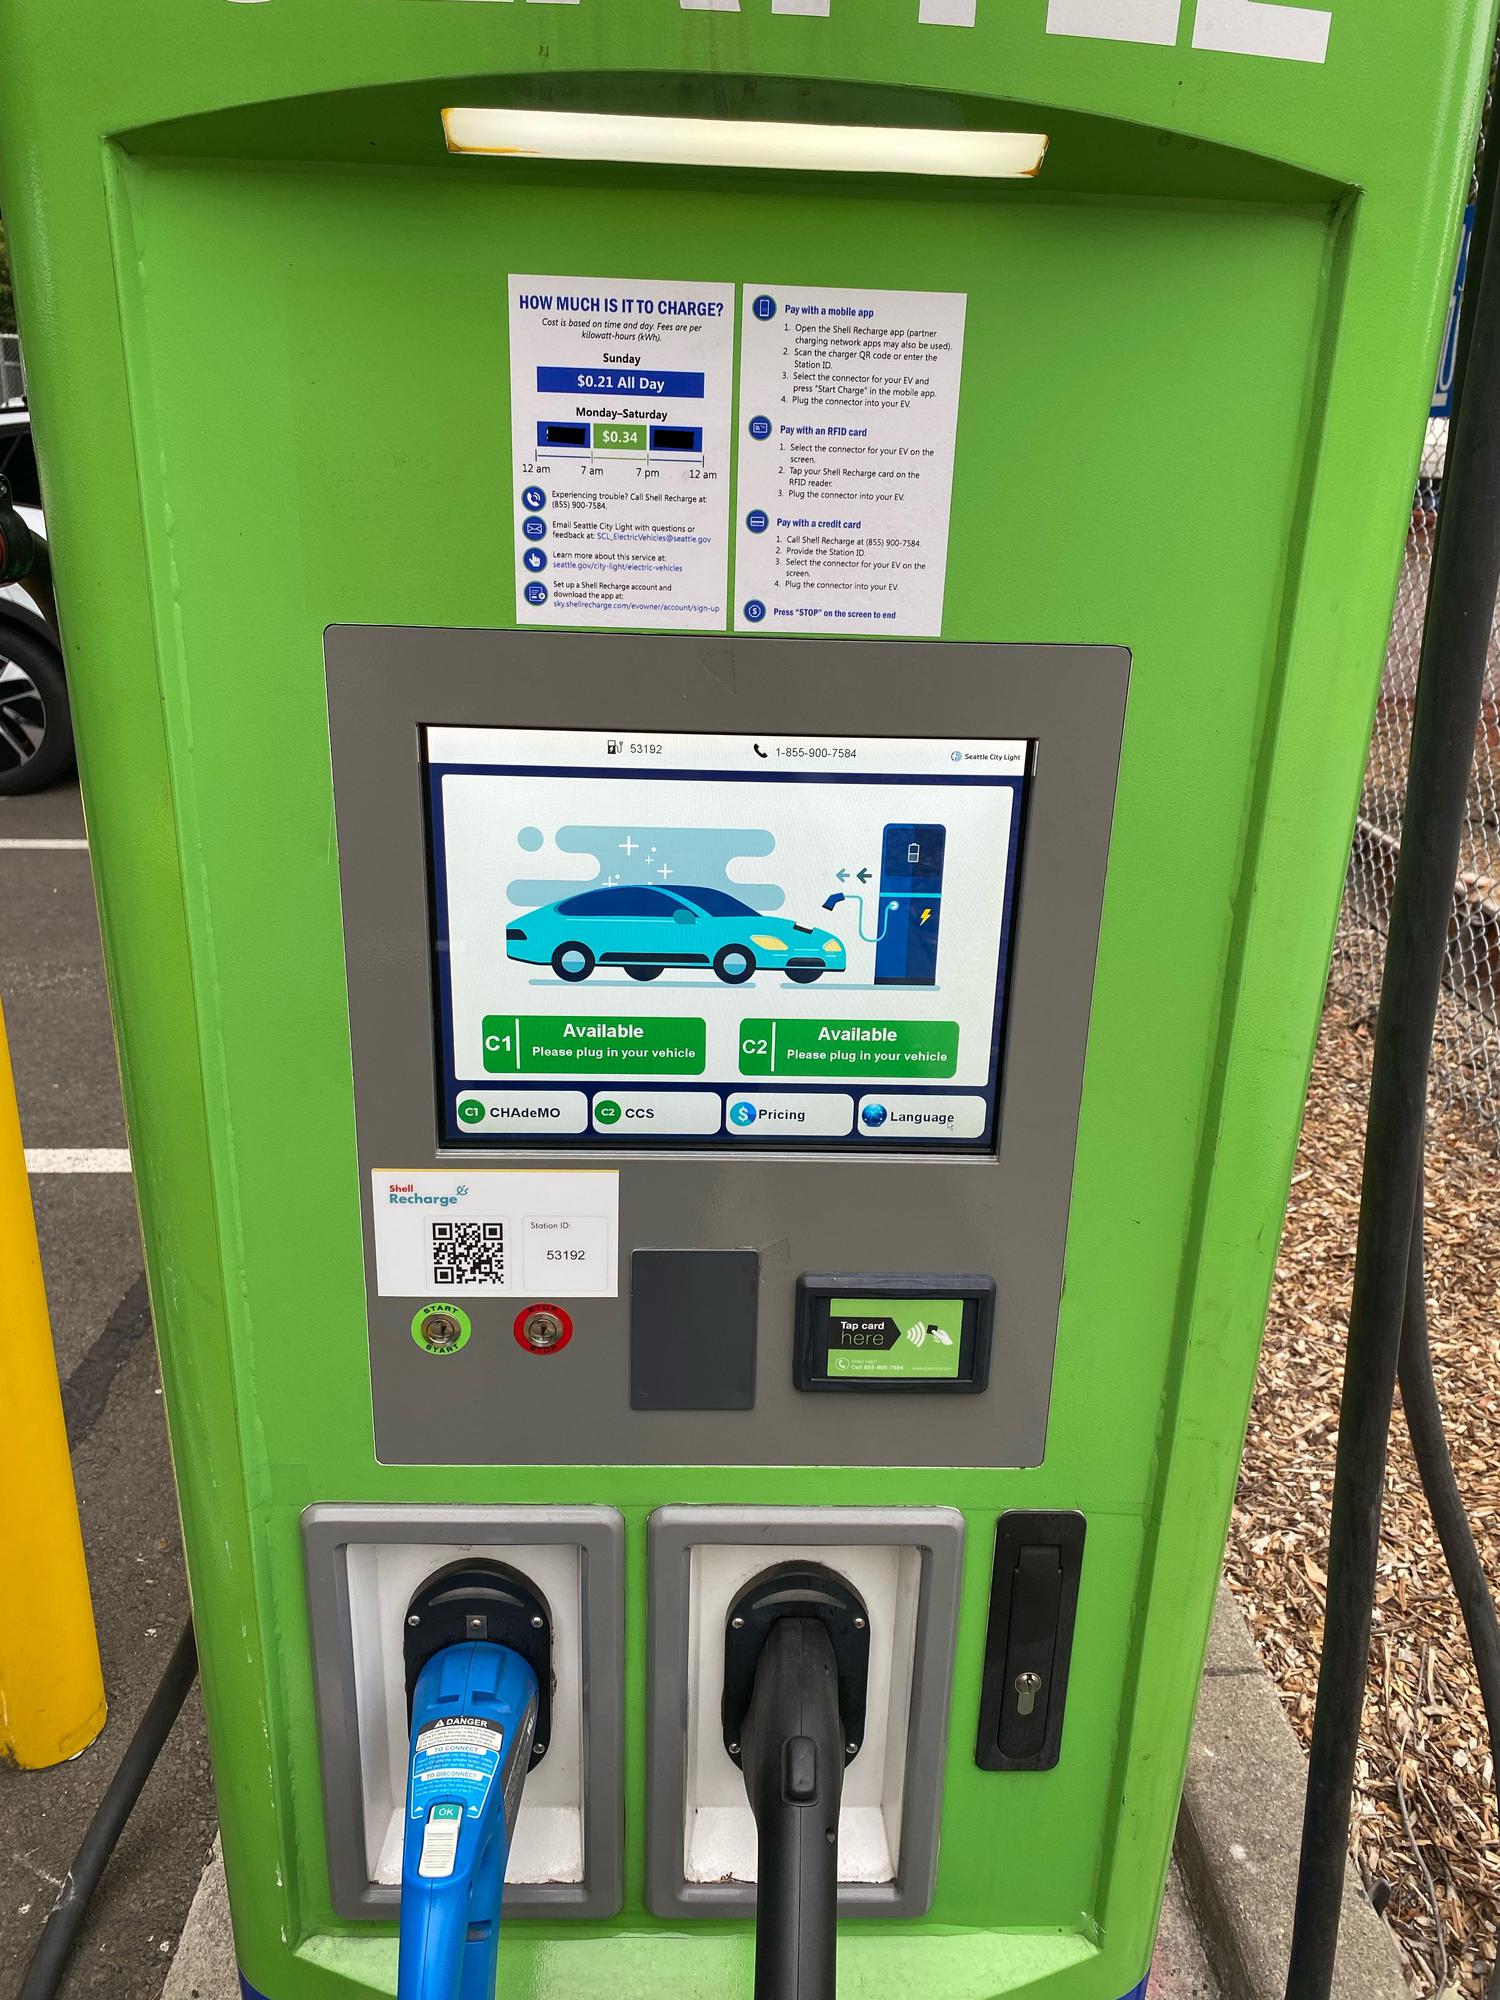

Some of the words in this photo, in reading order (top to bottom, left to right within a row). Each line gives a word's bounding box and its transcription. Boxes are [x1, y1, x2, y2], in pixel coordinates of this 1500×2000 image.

[519, 294, 553, 310] HOW
[556, 296, 600, 312] MUCH
[604, 298, 617, 312] IS
[621, 298, 634, 313] IT
[636, 299, 653, 314] TO
[657, 300, 723, 316] CHARGE?
[784, 304, 800, 315] Pay
[801, 305, 819, 315] with
[820, 307, 826, 315] a
[828, 306, 856, 316] mobile
[857, 309, 873, 319] app
[541, 317, 558, 326] Cost
[560, 318, 566, 326] is
[568, 318, 591, 327] based
[604, 320, 621, 329] time
[622, 320, 638, 329] and
[656, 322, 673, 331] Fees
[688, 325, 702, 333] per
[795, 323, 816, 334] Open
[818, 324, 830, 333] the
[832, 325, 851, 334] Shell
[852, 326, 888, 337] Recharge
[889, 329, 904, 338] app
[906, 328, 937, 337] (partner
[581, 330, 635, 340] kilowatt-hours
[602, 352, 641, 366] Sunday
[577, 374, 613, 388] $0.21
[617, 376, 634, 388] All
[639, 377, 664, 393] Day
[780, 424, 794, 436] Pay
[795, 425, 813, 434] with
[827, 426, 846, 436] RFID
[848, 428, 867, 436] card
[602, 430, 638, 443] $0.34
[522, 463, 533, 473] 12
[536, 465, 550, 473] am
[580, 465, 586, 474] 7
[589, 467, 603, 475] am
[636, 467, 642, 476] 7
[644, 469, 659, 479] pm
[689, 469, 700, 479] 12
[702, 471, 717, 479] am
[551, 490, 597, 501] Experiencing
[598, 492, 628, 500] trouble?
[629, 492, 643, 501] Call
[645, 493, 662, 501] Shell
[664, 494, 697, 504] Recharge
[551, 500, 570, 509] (855)
[552, 520, 571, 528] Email
[573, 521, 597, 529] Seattle
[599, 522, 613, 531] City
[614, 522, 633, 532] Light
[634, 523, 649, 531] with
[651, 525, 685, 533] questions
[776, 517, 791, 528] Pay
[792, 518, 809, 527] with
[817, 519, 841, 528] credit
[842, 520, 861, 529] card
[552, 530, 585, 539] feedback
[786, 535, 800, 543] Call
[802, 535, 819, 544] Shell
[821, 536, 854, 547] Recharge
[865, 538, 884, 547] (855)
[594, 552, 615, 560] about
[553, 580, 564, 588] Set
[581, 581, 597, 589] Shell
[598, 582, 630, 591] Recharge
[553, 590, 587, 598] download
[588, 591, 600, 599] the
[773, 607, 793, 616] Press
[834, 609, 846, 617] the
[873, 610, 881, 618] to
[882, 611, 896, 619] end
[630, 743, 662, 754] 53192
[775, 747, 856, 758] 1-855-900-7584
[989, 753, 1002, 761] City
[562, 1023, 643, 1038] Available
[817, 1026, 897, 1041] Available
[485, 1035, 510, 1051] C1
[742, 1039, 767, 1054] C2
[532, 1046, 573, 1056] Please
[576, 1046, 603, 1059] plug
[607, 1047, 618, 1057] in
[621, 1049, 648, 1059] your
[651, 1047, 695, 1057] vehicle
[787, 1049, 826, 1059] Please
[829, 1049, 856, 1062] plug
[859, 1050, 871, 1060] in
[874, 1053, 901, 1062] your
[904, 1051, 947, 1061] vehicle
[464, 1107, 478, 1116] C1
[489, 1107, 560, 1117] CHAdeMO
[601, 1108, 615, 1116] C2
[625, 1108, 654, 1118] CCS
[758, 1109, 805, 1122] Pricing
[890, 1111, 954, 1124] Language
[389, 1184, 413, 1192] Shell
[389, 1193, 459, 1207] Recharge
[530, 1221, 558, 1229] Station
[546, 1249, 585, 1260] 53192
[423, 1304, 460, 1314] START
[527, 1303, 559, 1312] STOP
[840, 1321, 858, 1331] Tap
[861, 1321, 884, 1329] card
[841, 1330, 884, 1345] here
[425, 1343, 460, 1354] START
[445, 1717, 488, 1728] DANGER
[436, 1770, 477, 1779] DISCONNECT
[438, 1807, 455, 1817] OK
